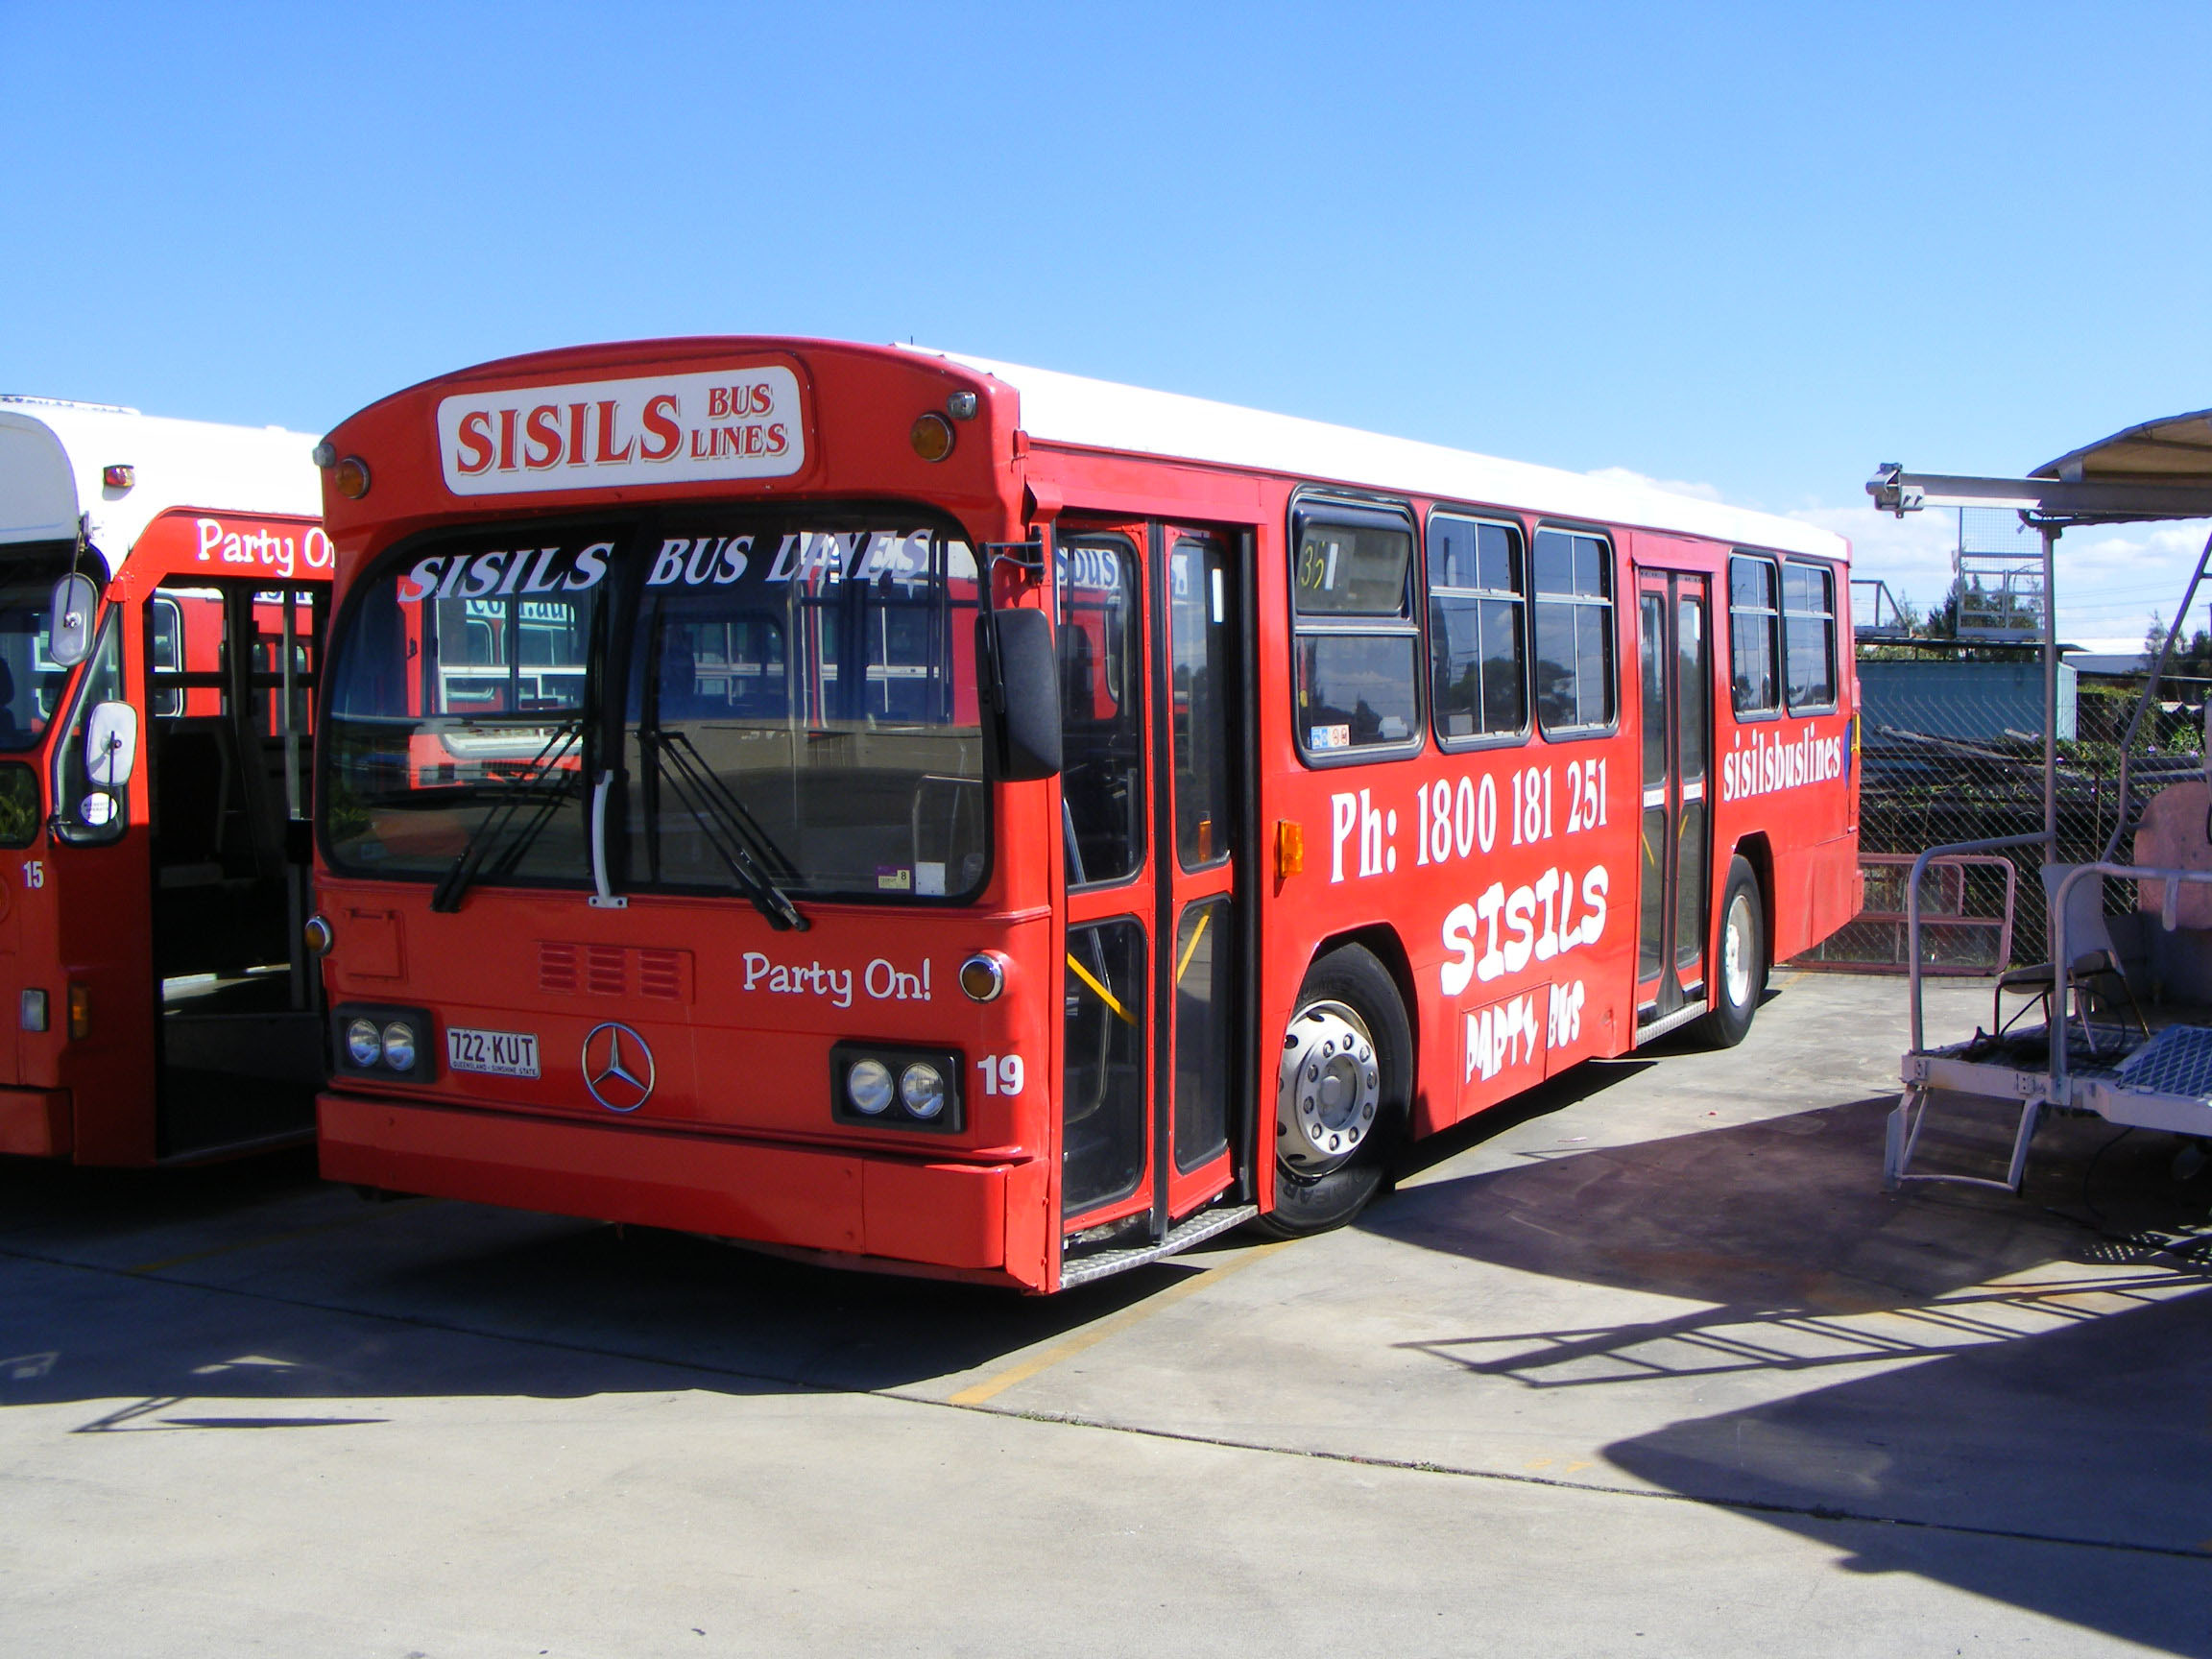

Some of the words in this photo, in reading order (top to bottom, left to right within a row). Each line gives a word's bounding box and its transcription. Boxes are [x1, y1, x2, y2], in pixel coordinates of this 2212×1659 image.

[456, 394, 684, 475] SISILS
[708, 383, 774, 419] BUS
[690, 422, 788, 460] LINES
[196, 518, 294, 577] Party
[397, 542, 615, 603] SISILS
[645, 536, 755, 586] BUS
[765, 528, 933, 582] LINES
[1723, 721, 1841, 803] sisilsbuslines
[1331, 787, 1398, 883] Ph:
[1416, 773, 1498, 866] 1800
[1512, 765, 1553, 845] 181
[1566, 757, 1608, 834] 251
[23, 860, 44, 889] 15
[1440, 864, 1609, 997] SISILS
[742, 951, 854, 1009] Party
[865, 958, 932, 1001] On!
[1465, 995, 1539, 1084] PARTY
[1547, 979, 1584, 1049] BUS
[976, 1054, 1024, 1096] 19
